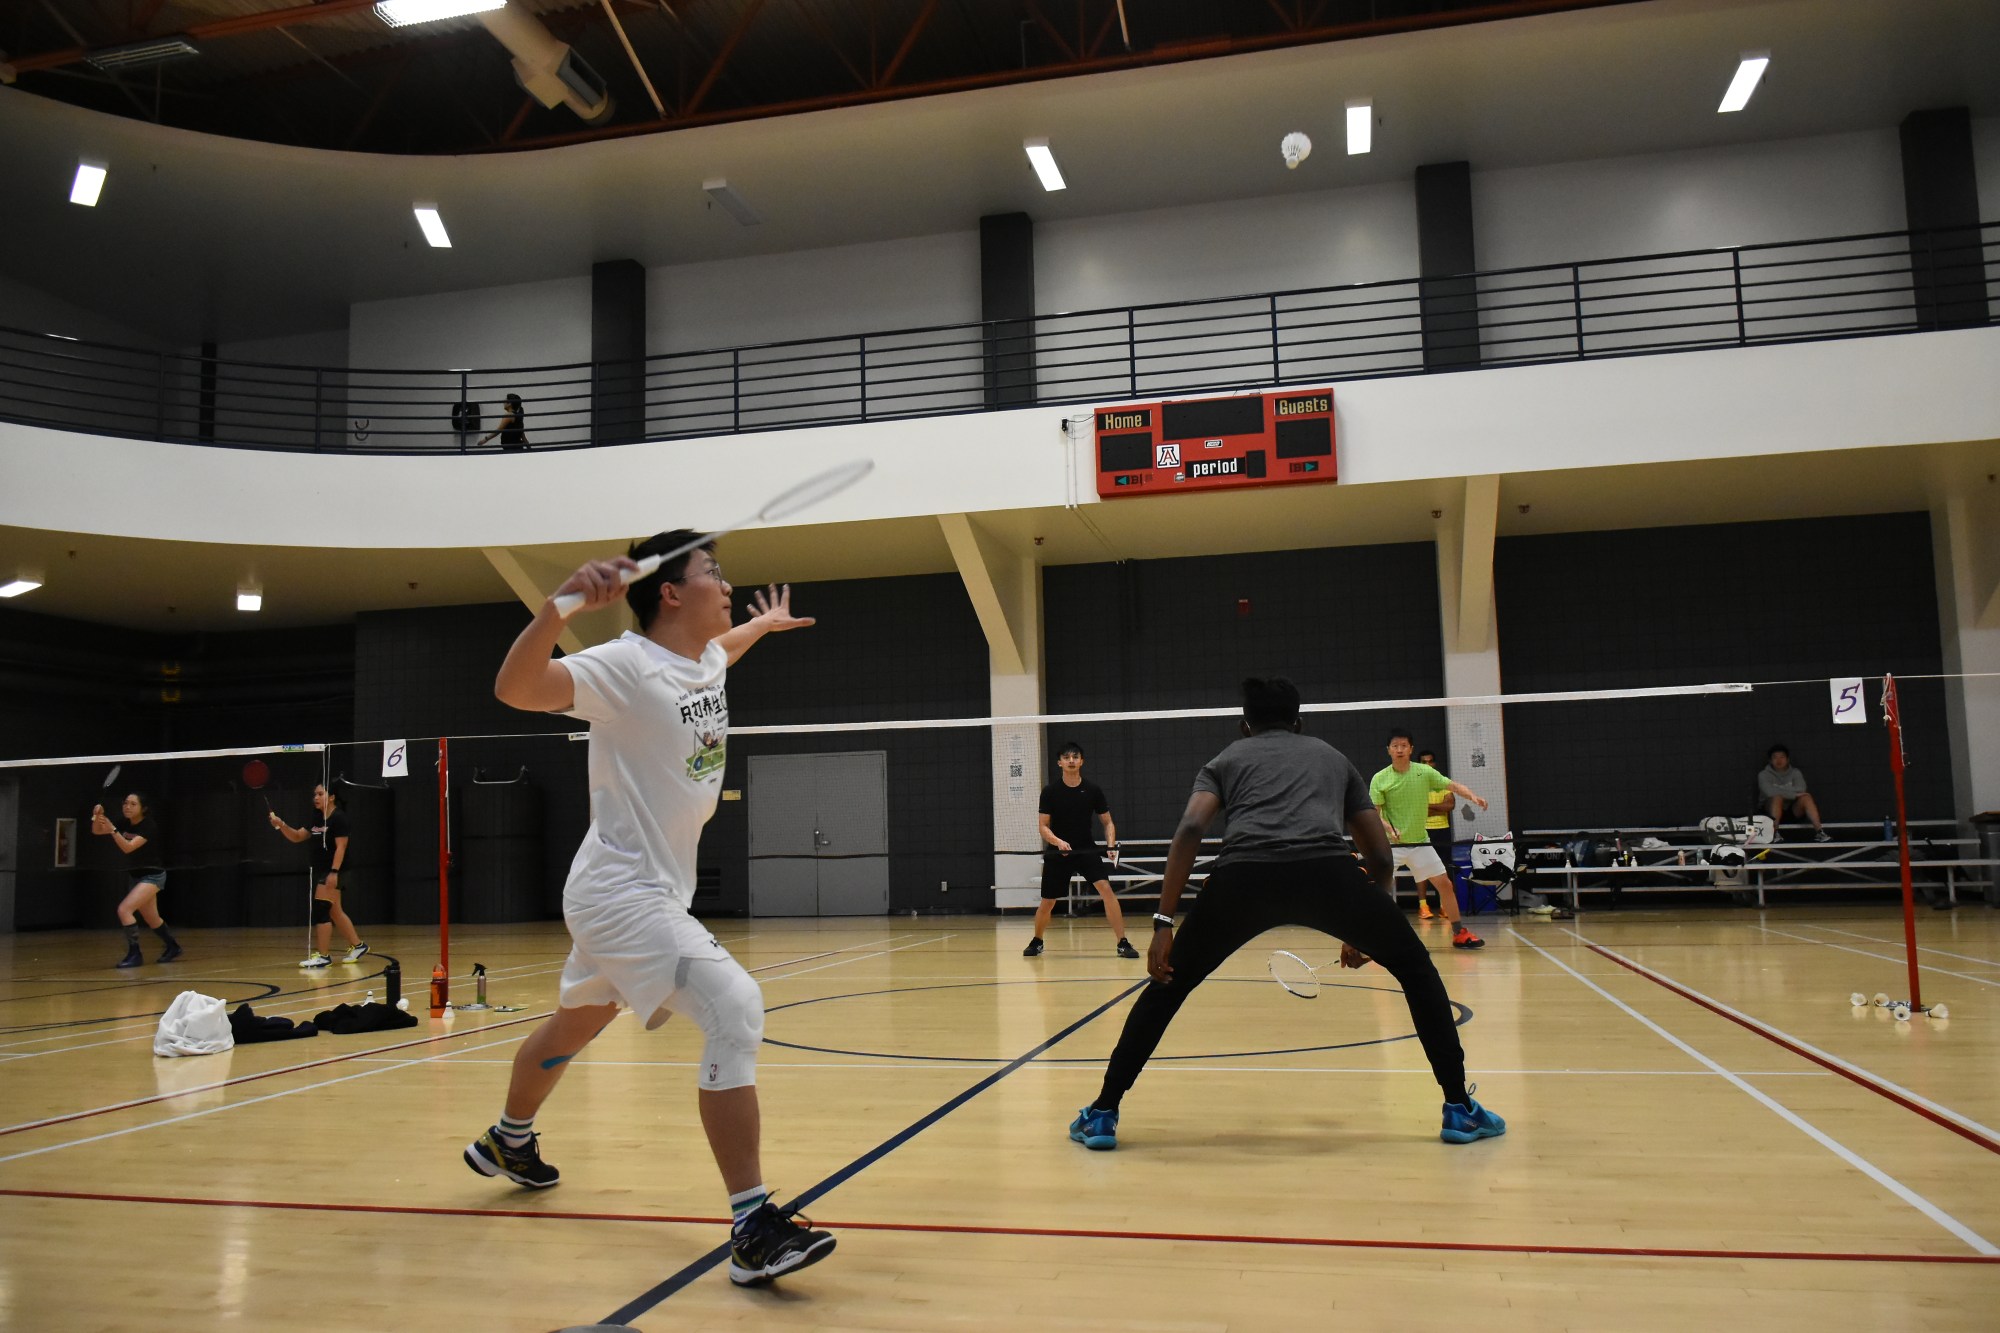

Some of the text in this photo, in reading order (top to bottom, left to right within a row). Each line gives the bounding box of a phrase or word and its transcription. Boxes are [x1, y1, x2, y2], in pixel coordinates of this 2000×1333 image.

[1279, 397, 1328, 415] Guests
[1105, 413, 1142, 430] Home
[1158, 447, 1179, 466] A
[1193, 457, 1238, 478] period
[1834, 682, 1861, 716] 5
[387, 744, 406, 768] 6
[1735, 823, 1764, 837] YOEX
